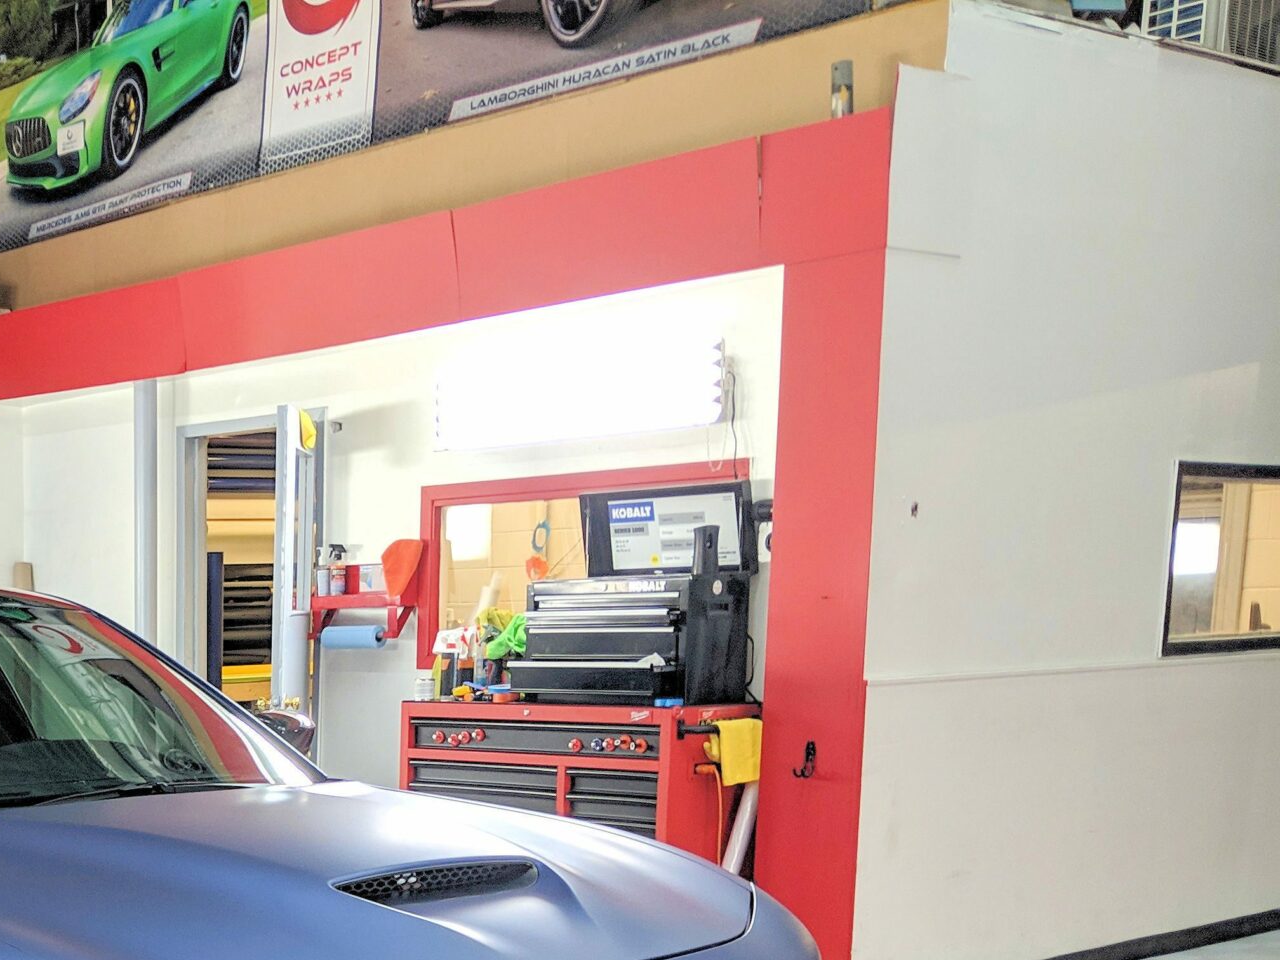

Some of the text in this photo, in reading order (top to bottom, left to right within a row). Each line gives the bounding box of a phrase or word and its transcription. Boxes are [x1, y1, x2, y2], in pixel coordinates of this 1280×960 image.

[280, 41, 362, 78] CONCEPT
[470, 33, 731, 111] LAMBORGHINI HURACAN SATIN BLACK
[286, 67, 352, 98] WRAPS
[36, 215, 72, 233] MERCEDES
[108, 195, 130, 211] PAINT
[129, 178, 182, 201] PROTECTION
[611, 506, 652, 519] KOBALT
